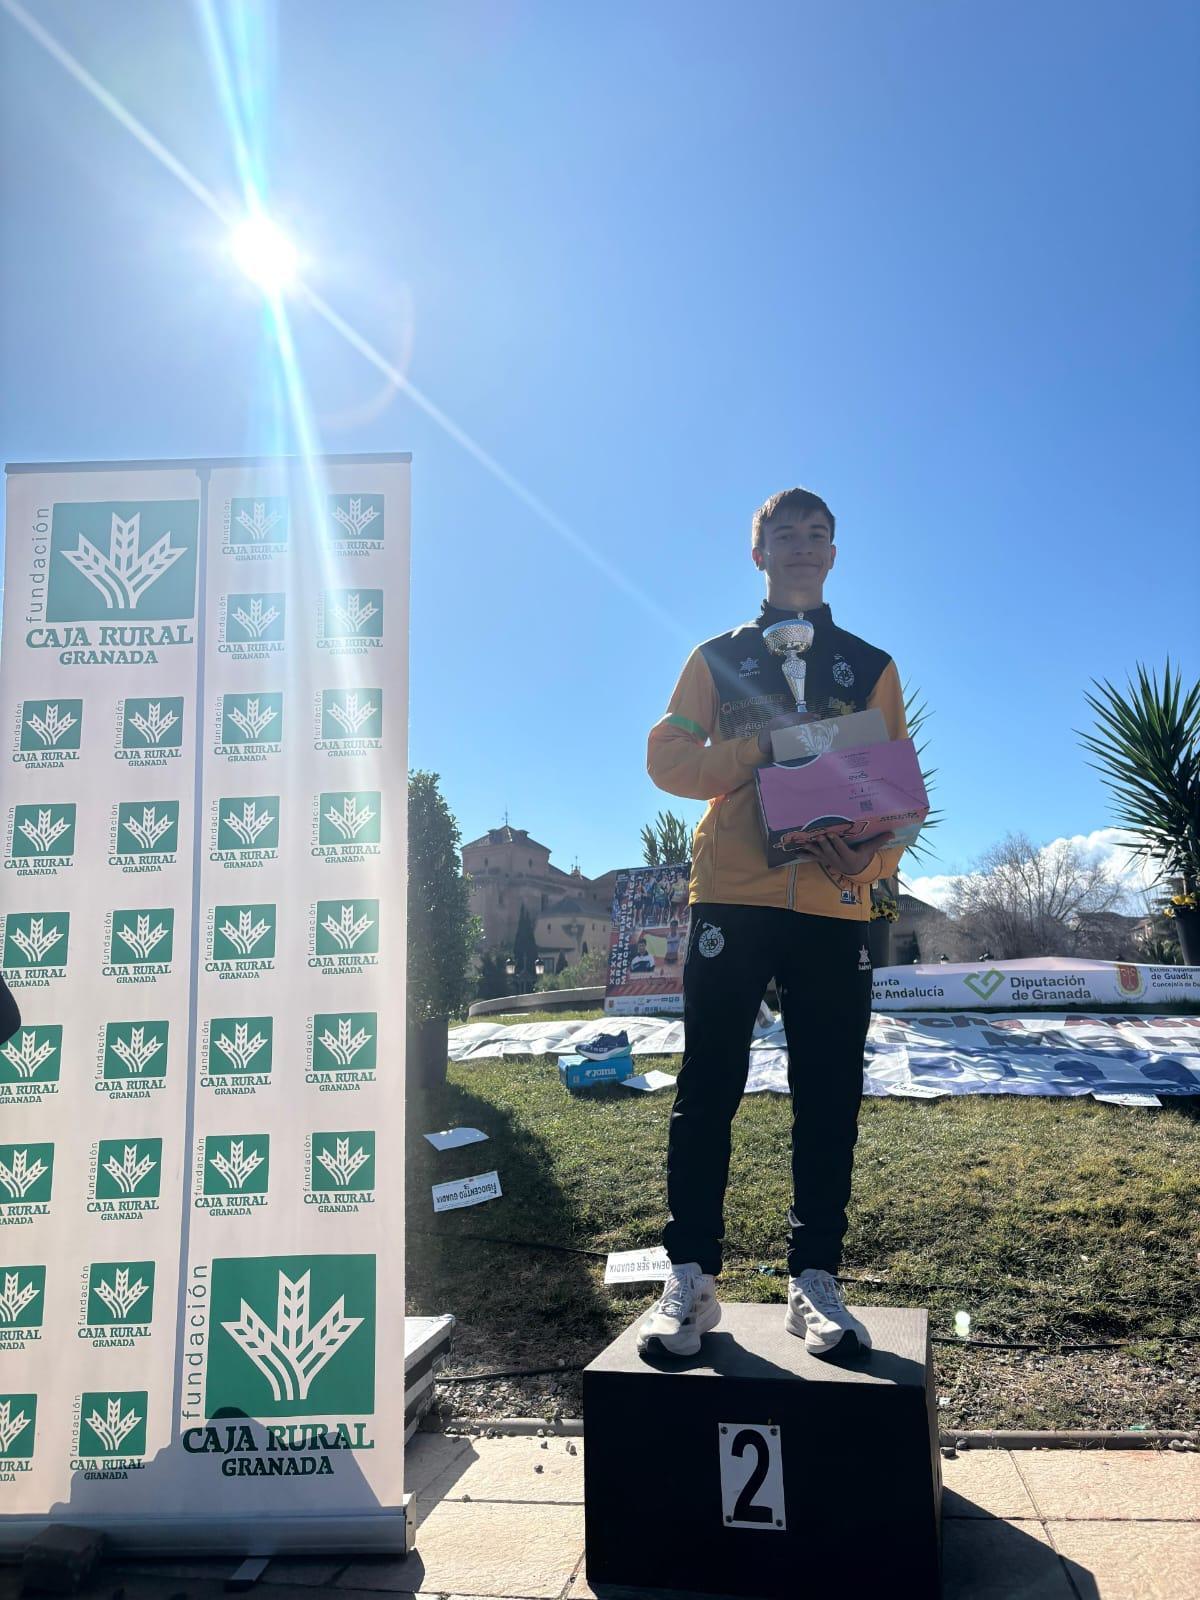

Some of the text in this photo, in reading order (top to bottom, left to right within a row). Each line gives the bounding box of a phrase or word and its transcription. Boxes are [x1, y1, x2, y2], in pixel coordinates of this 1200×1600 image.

[26, 508, 49, 623] fundación
[26, 626, 193, 648] CAJA RURAL
[218, 643, 284, 653] CAJA RURAL
[60, 651, 158, 664] GRANADA
[215, 696, 223, 744] fundación
[314, 691, 322, 739] fundación
[13, 703, 22, 752] fundación
[115, 700, 124, 749] fundación
[215, 744, 281, 755] CAJA RURAL
[314, 740, 382, 750] CAJA RURAL
[12, 752, 80, 763] CAJA RURAL
[115, 749, 182, 760] CAJA RURAL
[25, 761, 65, 769] GRANADA
[129, 758, 168, 767] GRANADA
[210, 800, 219, 850] fundación
[312, 794, 320, 845] fundación
[5, 807, 14, 858] fundación
[108, 804, 118, 854] fundación
[210, 851, 279, 862] CAJA RURAL
[312, 846, 381, 856] CAJA RURAL
[4, 858, 73, 869] CAJA RURAL
[109, 855, 176, 866] CAJA RURAL
[224, 860, 263, 868] GRANADA
[325, 854, 364, 863] GRANADA
[16, 868, 57, 876] GRANADA
[122, 865, 161, 873] GRANADA
[205, 908, 214, 960] fundación
[308, 903, 316, 955] fundación
[103, 912, 112, 964] fundación
[308, 956, 378, 967] CAJA RURAL
[621, 936, 630, 984] MARCHA
[102, 965, 171, 976] CAJA RURAL
[205, 961, 275, 972] CAJA RURAL
[322, 965, 362, 975] GRANADA
[0, 968, 66, 979] AJA RURAL
[117, 975, 156, 983] GRANADA
[219, 970, 259, 980] GRANADA
[1151, 972, 1162, 980] de
[8, 979, 50, 987] GRANADA
[872, 979, 900, 987] unta
[1010, 975, 1086, 989] Diputación
[886, 986, 944, 999] Andalucía
[1012, 988, 1091, 1000] de Granada
[200, 1021, 210, 1075] fundación
[306, 1017, 314, 1071] fundación
[95, 1025, 105, 1079] fundación
[201, 1074, 271, 1088] CAJA RURAL
[306, 1072, 377, 1083] CAJA RURAL
[16, 1084, 58, 1093] RURAL
[95, 1080, 166, 1091] CAJA RURAL
[214, 1086, 256, 1096] GRANADA
[319, 1082, 360, 1092] GRANADA
[109, 1091, 150, 1099] GRANADA
[195, 1138, 205, 1195] fundación
[304, 1135, 312, 1191] fundación
[87, 1142, 98, 1199] fundación
[195, 1196, 268, 1207] CAJA RURAL
[304, 1193, 376, 1204] CAJA RURAL
[8, 1203, 50, 1215] RURAL
[87, 1201, 159, 1213] CAJA RURAL
[209, 1207, 252, 1217] GRANADA
[318, 1204, 359, 1213] GRANADA
[101, 1212, 143, 1221] GRANADA
[610, 1264, 636, 1272] GUADIX
[636, 1262, 650, 1272] SER
[78, 1266, 89, 1325] fundación
[78, 1326, 151, 1339] CAJA RURAL
[92, 1338, 135, 1348] GRANADA
[182, 1264, 208, 1420] fundación
[70, 1395, 81, 1456] fundación
[184, 1423, 374, 1452] CAJA RURAL
[0, 1459, 32, 1472] URAL
[70, 1459, 144, 1470] CAJA RURAL
[222, 1456, 334, 1477] GRANADA
[84, 1470, 128, 1480] GRANADA
[732, 1428, 773, 1523] 2
